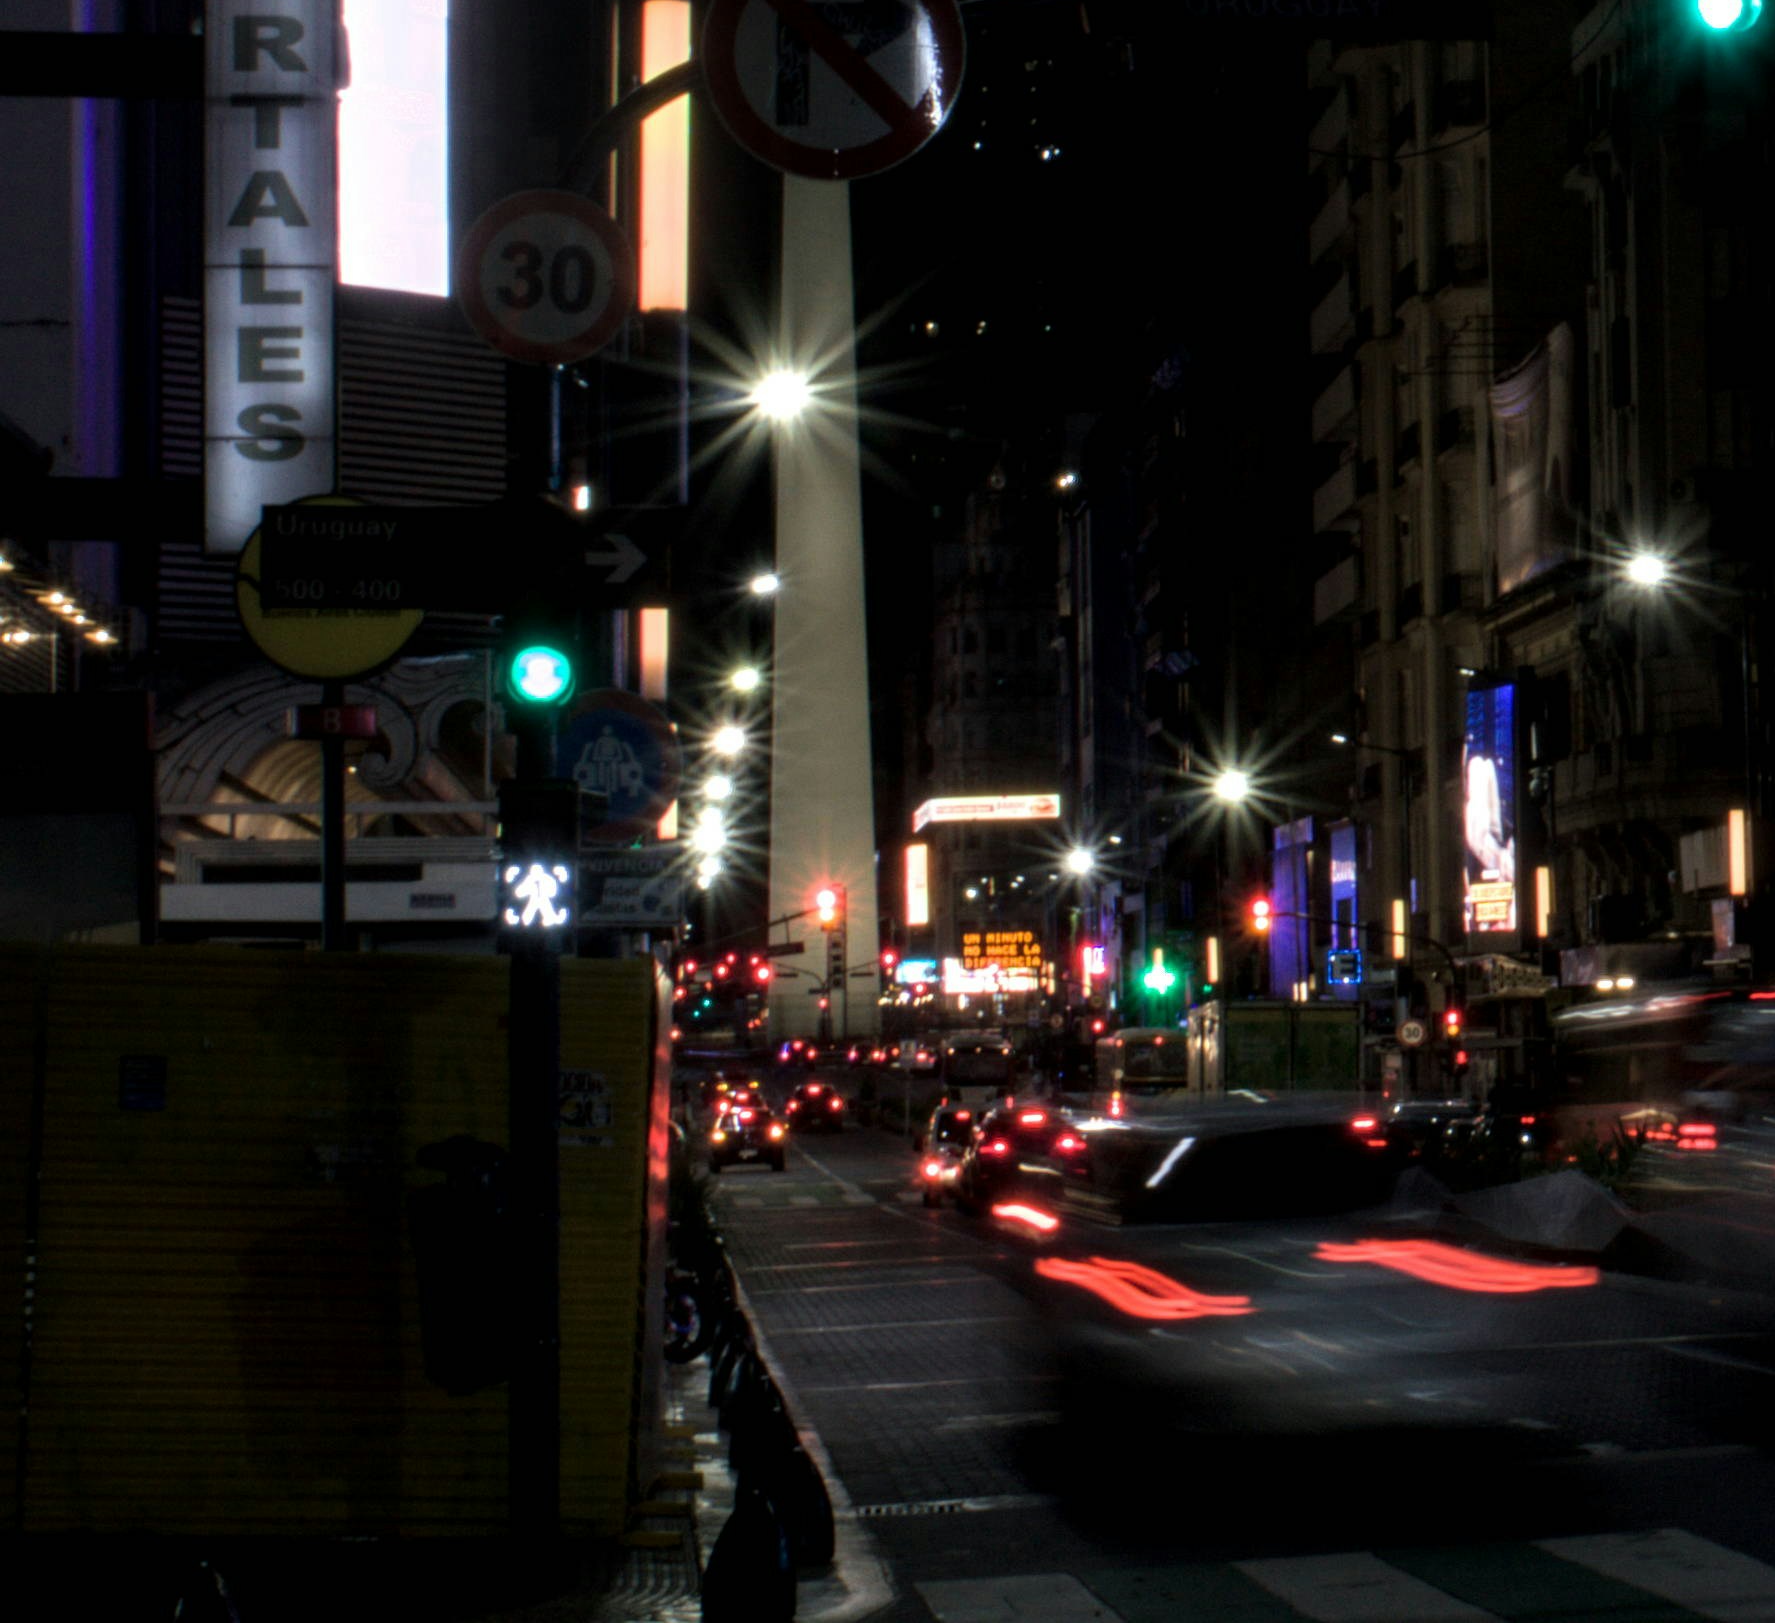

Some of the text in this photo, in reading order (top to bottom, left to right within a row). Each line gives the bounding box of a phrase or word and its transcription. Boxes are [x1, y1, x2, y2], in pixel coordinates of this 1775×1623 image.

[496, 240, 596, 314] 30
[275, 513, 399, 544] Uruguay
[274, 577, 326, 602] 500
[351, 577, 401, 602] 400
